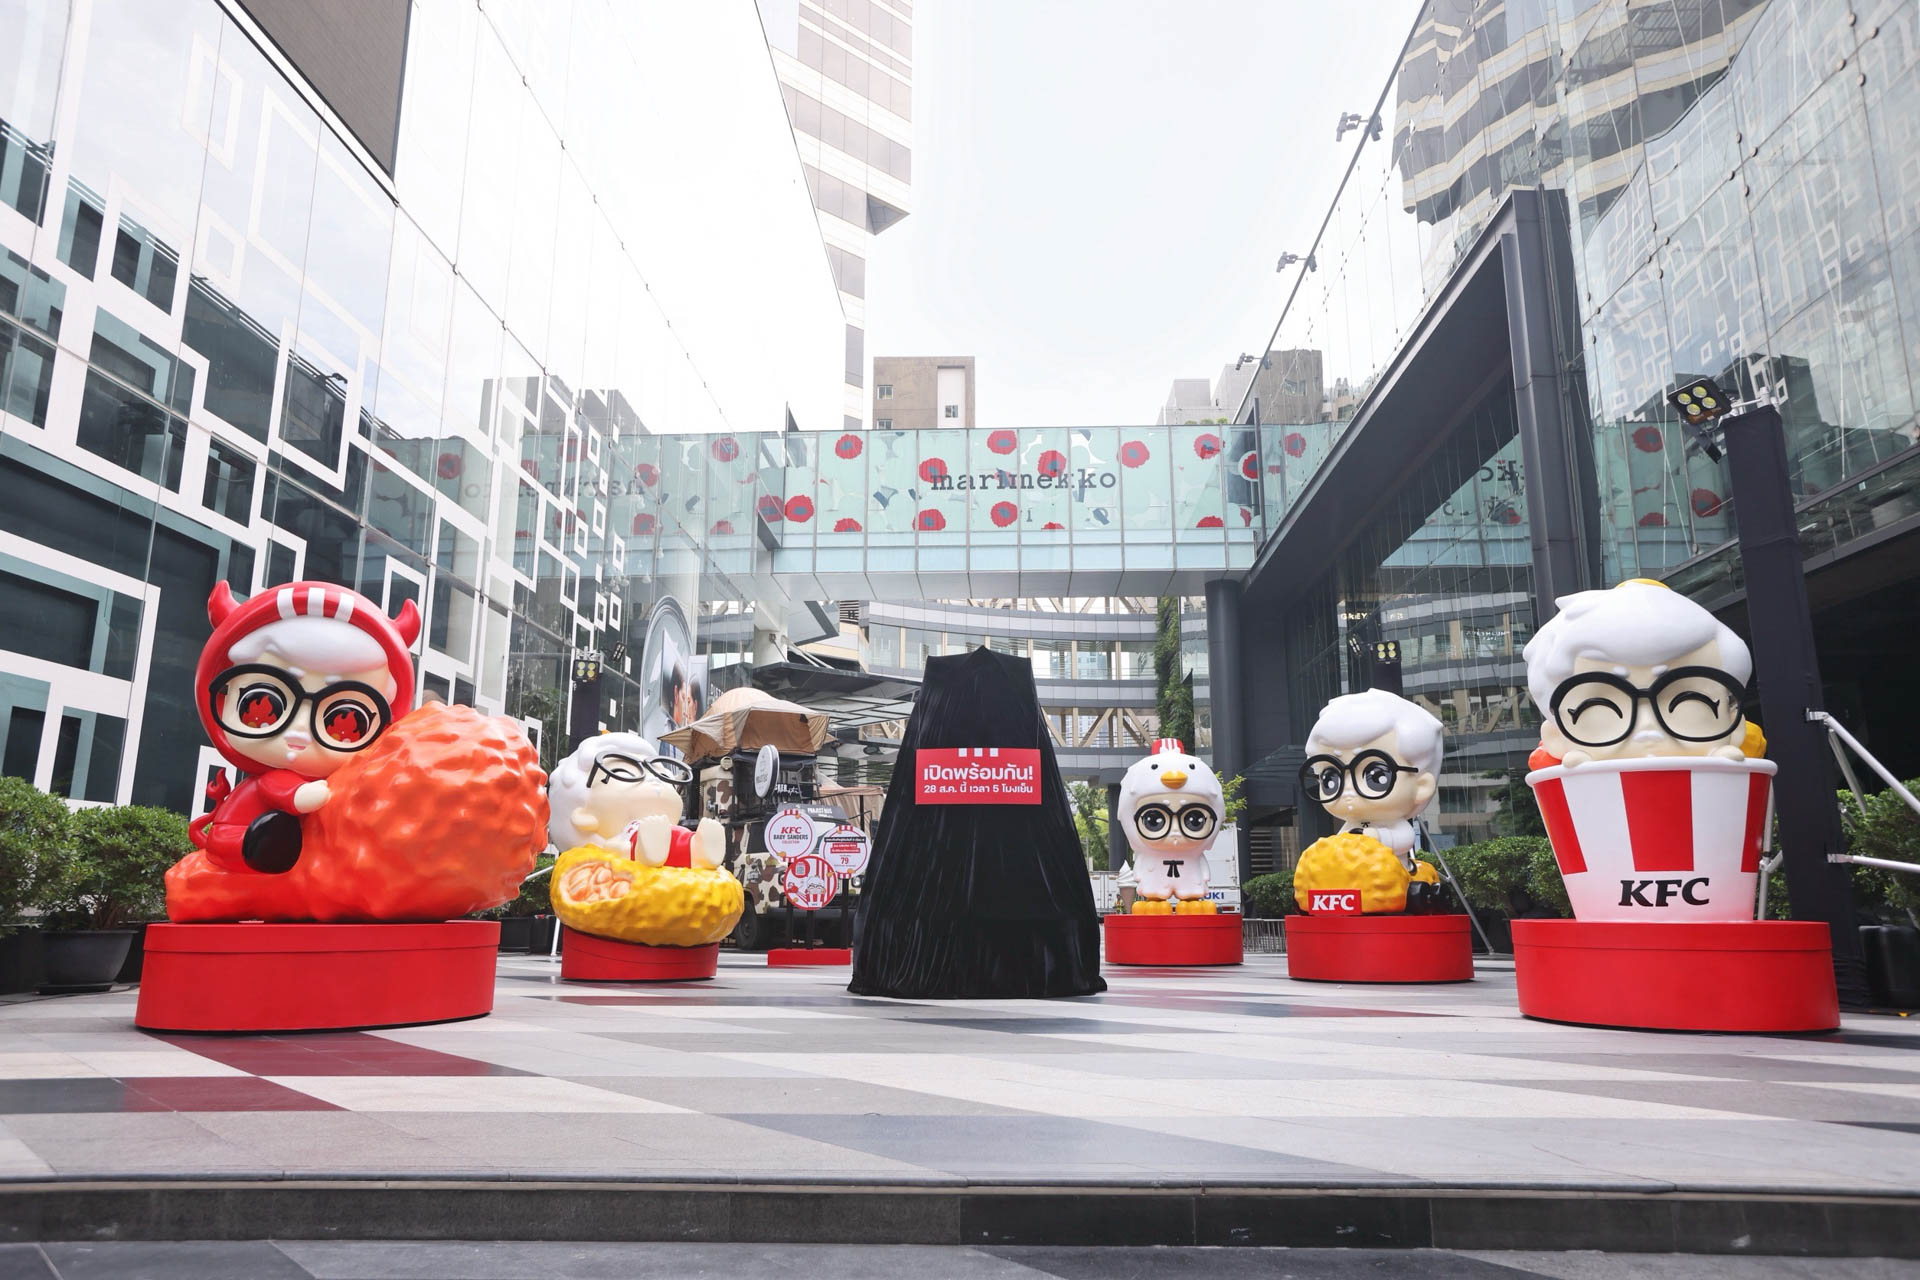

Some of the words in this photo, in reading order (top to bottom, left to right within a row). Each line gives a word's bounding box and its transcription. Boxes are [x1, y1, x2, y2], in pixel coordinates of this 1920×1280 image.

[930, 469, 1116, 490] marimekko
[923, 762, 1033, 780] เปิดพร้อมกัน!
[924, 785, 937, 793] 28
[939, 784, 957, 793] ส.ค.
[959, 781, 967, 793] นี้
[969, 784, 990, 793] เวลา
[992, 784, 999, 793] 5
[1002, 782, 1033, 793] โมงเย็น
[781, 826, 802, 834] KFC
[840, 856, 849, 865] 79
[1618, 877, 1710, 907] KFC
[1311, 894, 1355, 911] KFC
